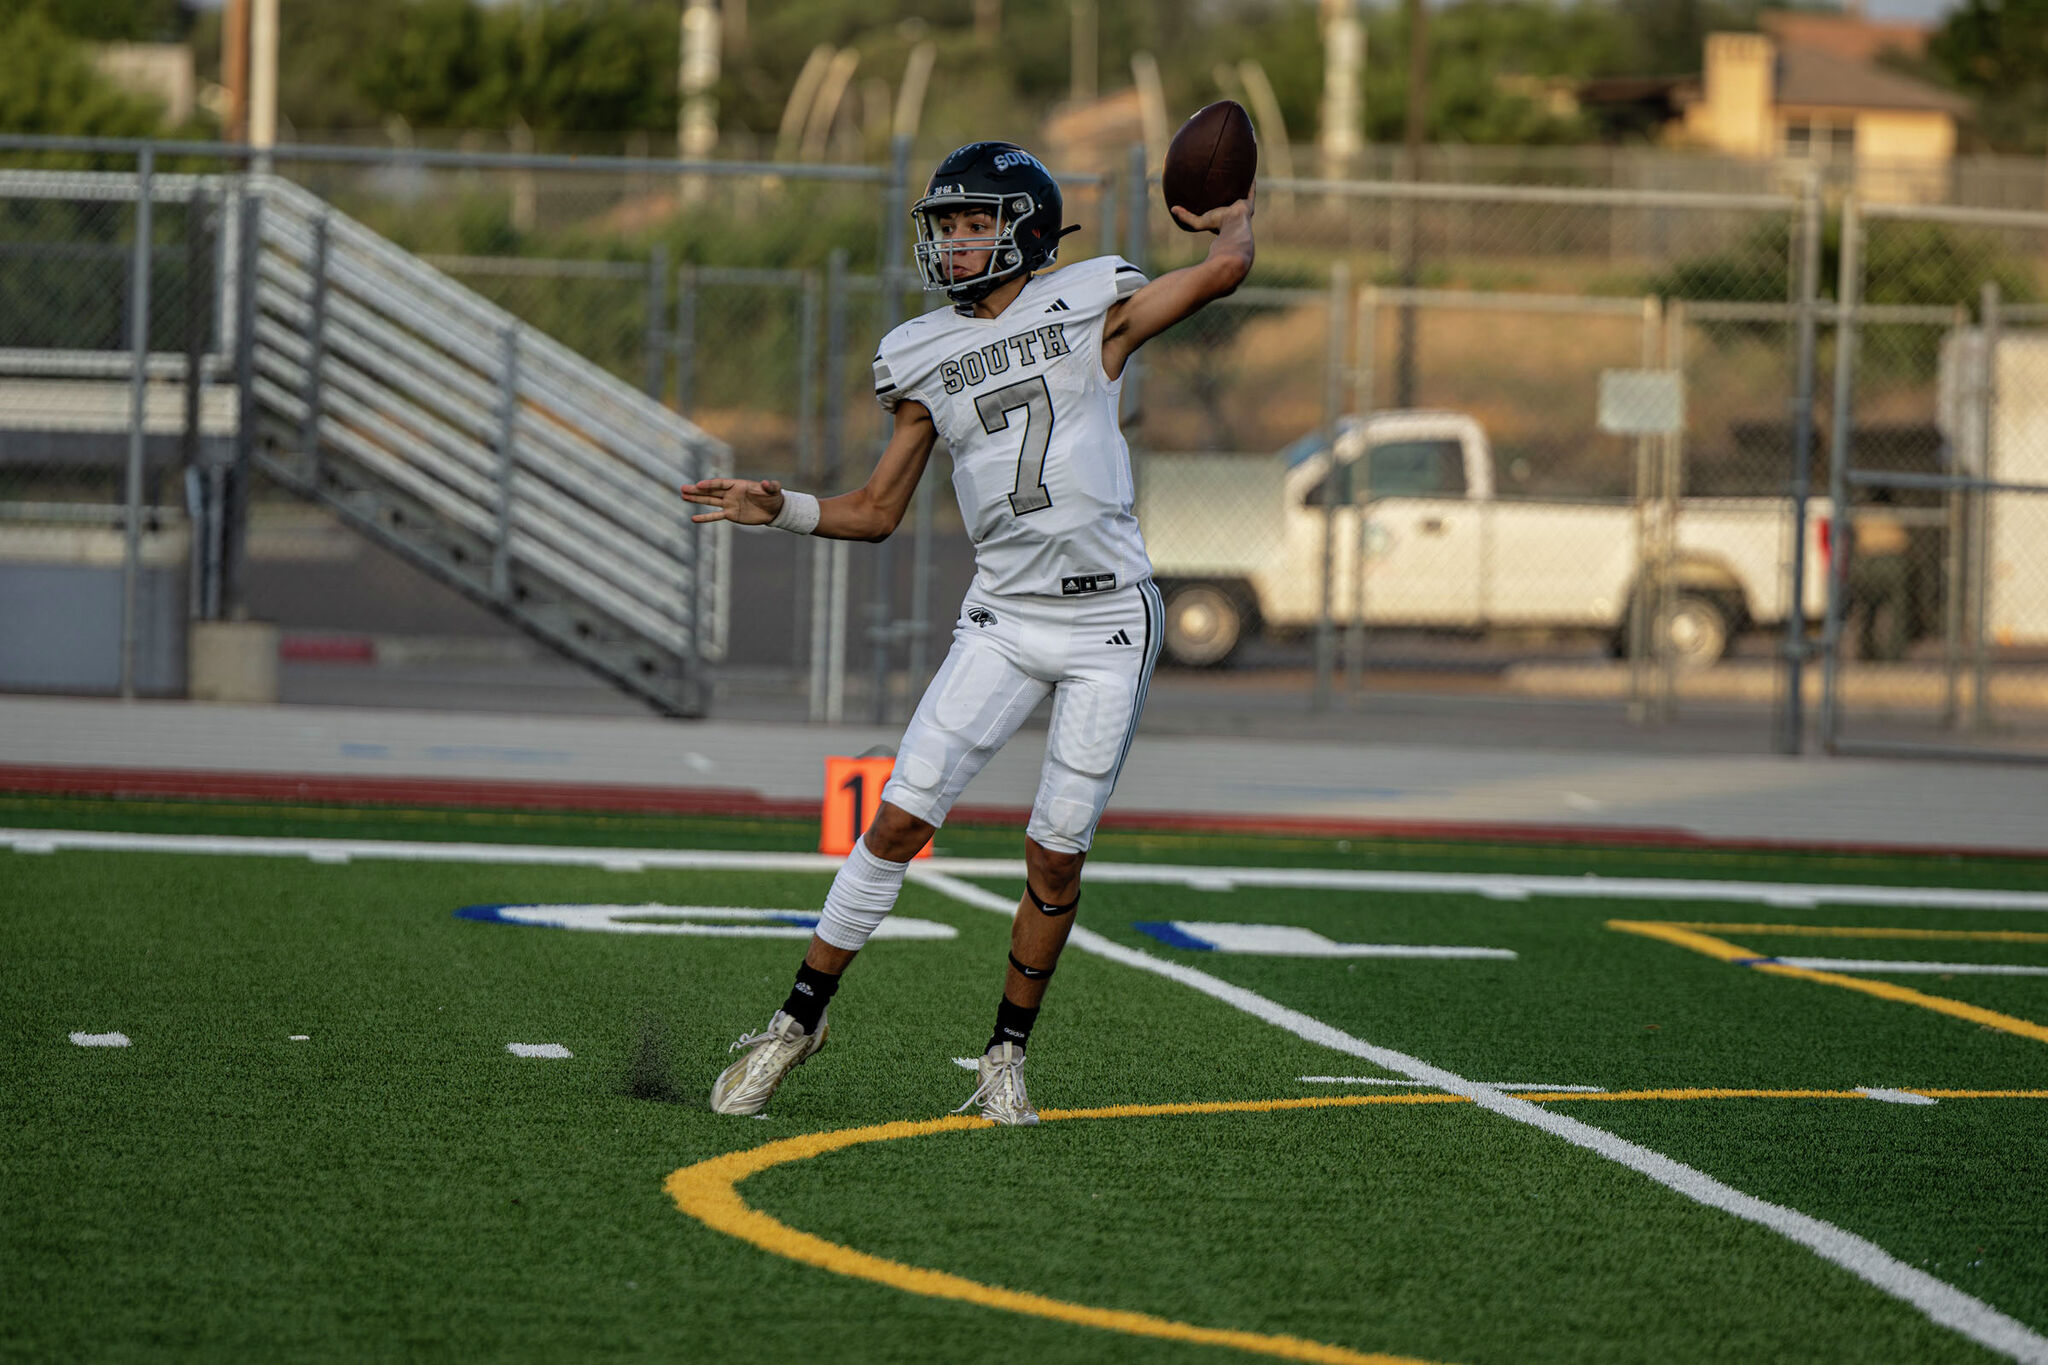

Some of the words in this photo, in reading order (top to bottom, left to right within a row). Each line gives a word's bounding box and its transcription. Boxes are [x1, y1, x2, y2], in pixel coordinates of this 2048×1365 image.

[939, 323, 1071, 395] SOUTH
[973, 374, 1055, 517] 7
[1003, 1026, 1026, 1039] adidas
